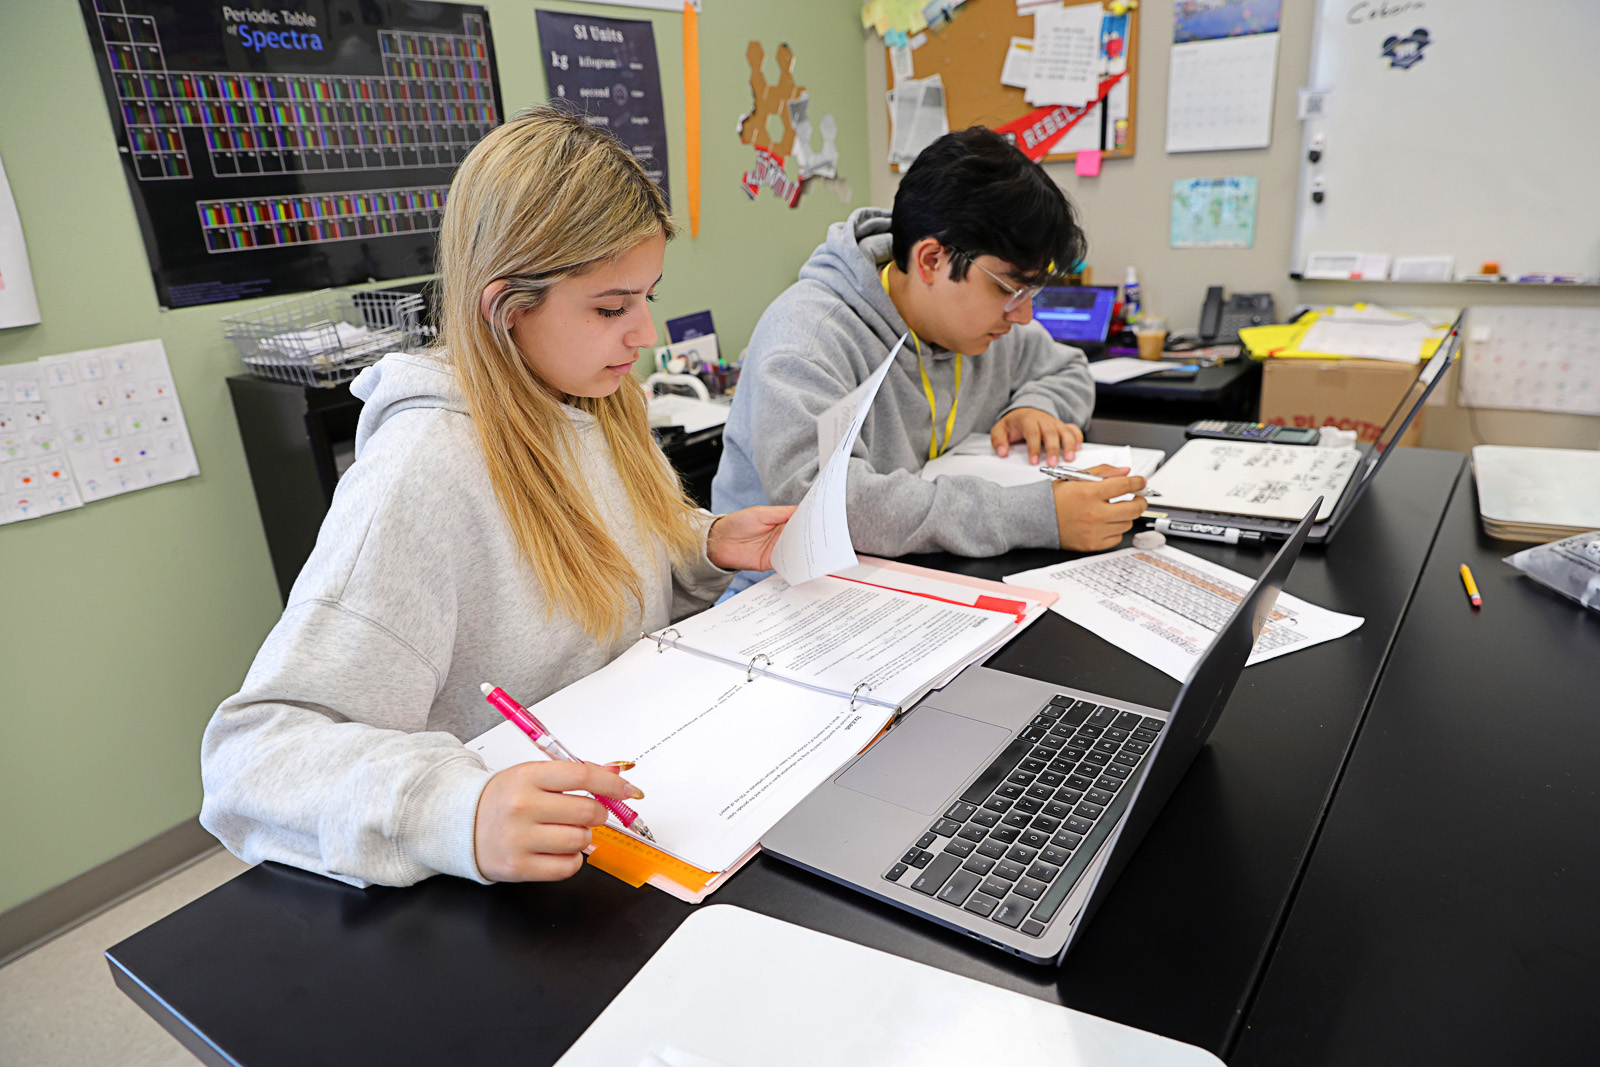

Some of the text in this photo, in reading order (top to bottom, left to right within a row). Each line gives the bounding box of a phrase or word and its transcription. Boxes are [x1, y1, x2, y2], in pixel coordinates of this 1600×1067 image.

[222, 5, 317, 28] Periodic Table
[226, 24, 324, 54] of Spectra
[573, 24, 624, 43] SI Units
[551, 51, 569, 71] kg
[578, 55, 617, 70] kilogram
[579, 86, 610, 98] second
